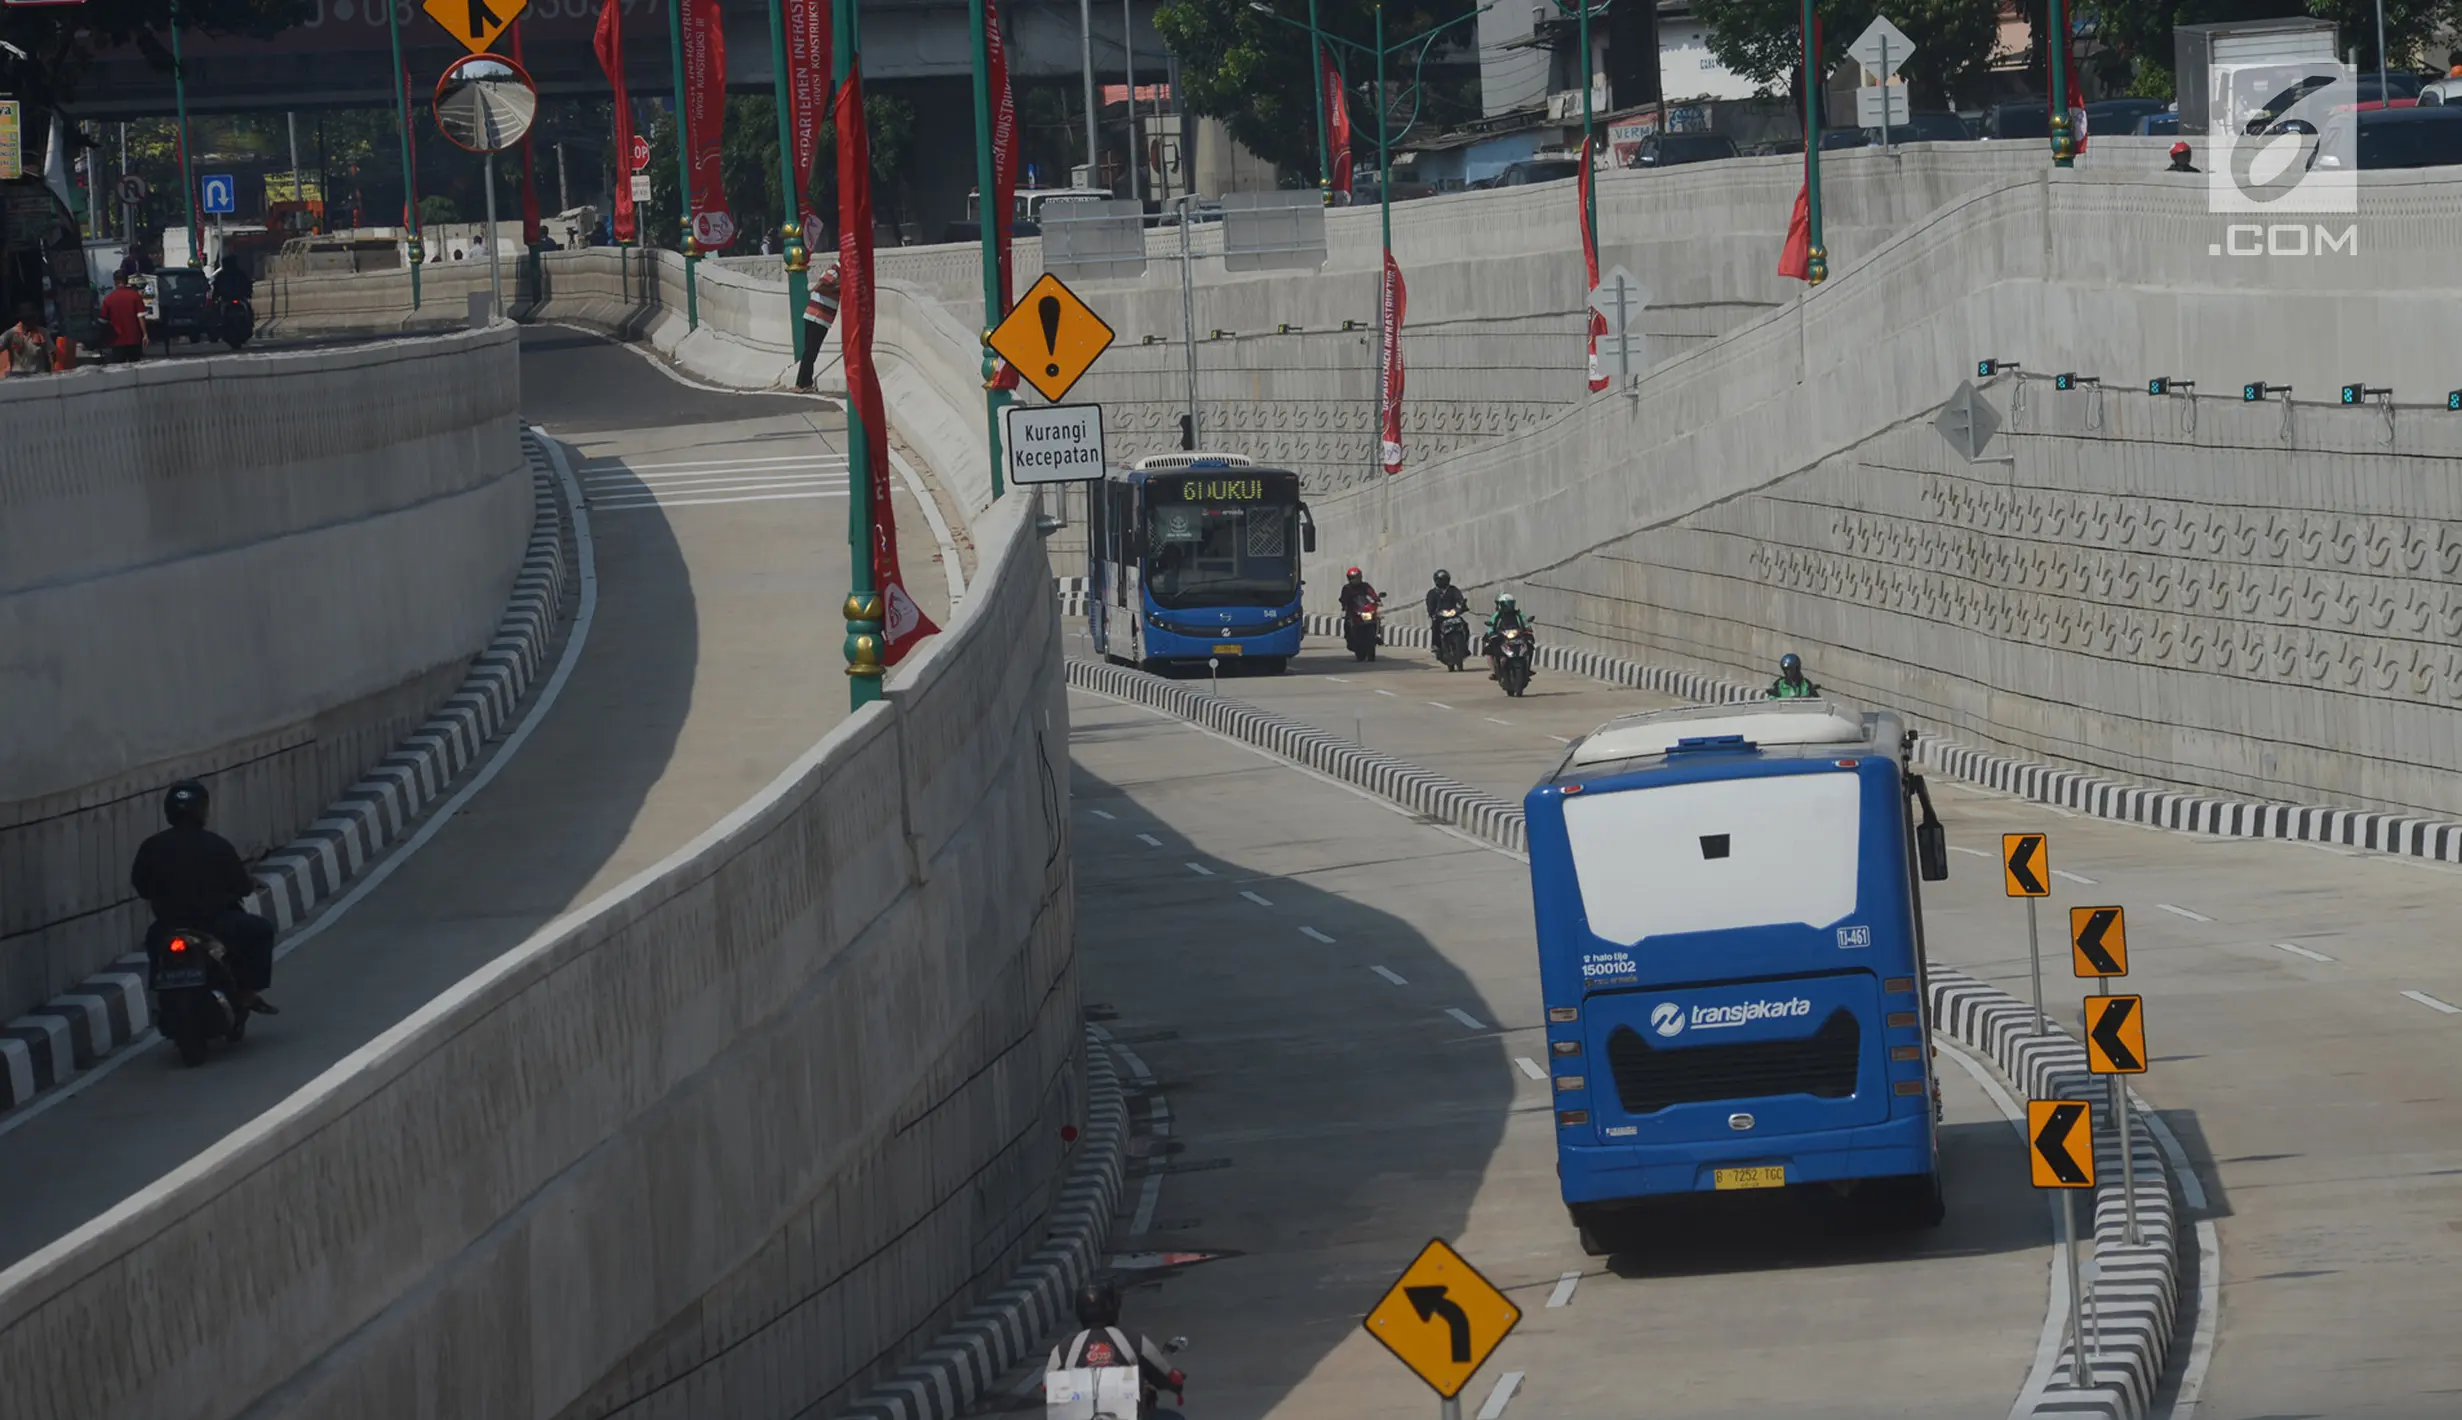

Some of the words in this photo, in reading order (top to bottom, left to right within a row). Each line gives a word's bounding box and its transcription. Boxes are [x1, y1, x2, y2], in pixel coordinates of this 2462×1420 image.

[1025, 420, 1086, 444] Kurangi
[1015, 446, 1099, 470] Kecepatan
[1582, 960, 1637, 976] 1500102
[1691, 997, 1811, 1029] transjakarta
